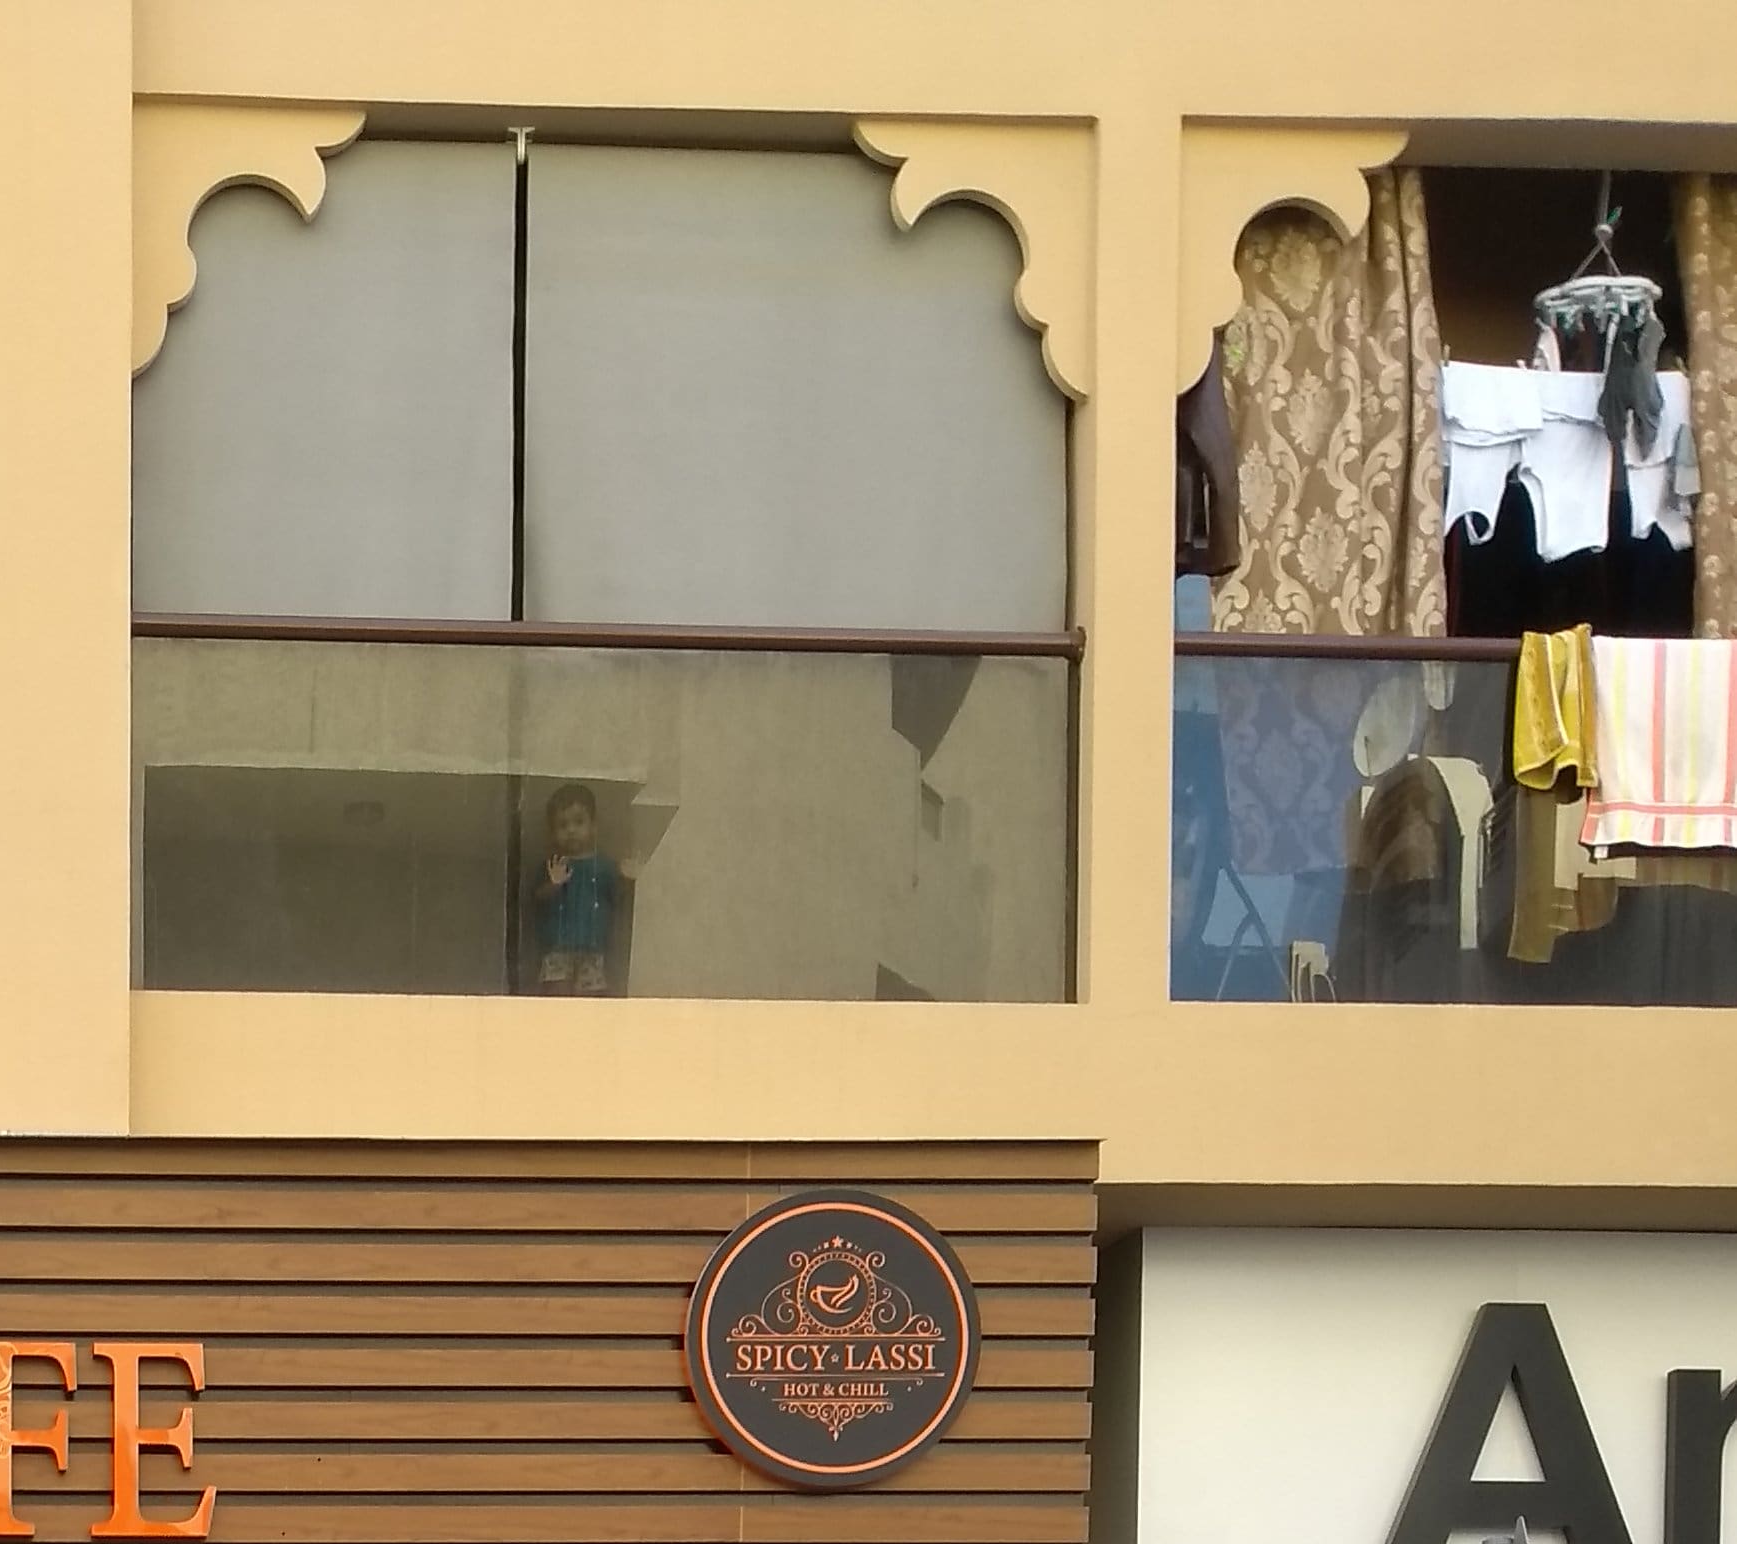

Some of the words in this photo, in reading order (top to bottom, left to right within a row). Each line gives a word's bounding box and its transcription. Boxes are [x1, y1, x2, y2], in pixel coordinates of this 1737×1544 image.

[735, 1344, 830, 1371] SPICY
[844, 1344, 937, 1371] LASSI
[783, 1382, 819, 1397] HOT
[822, 1382, 835, 1397] &
[838, 1382, 889, 1397] CHILL
